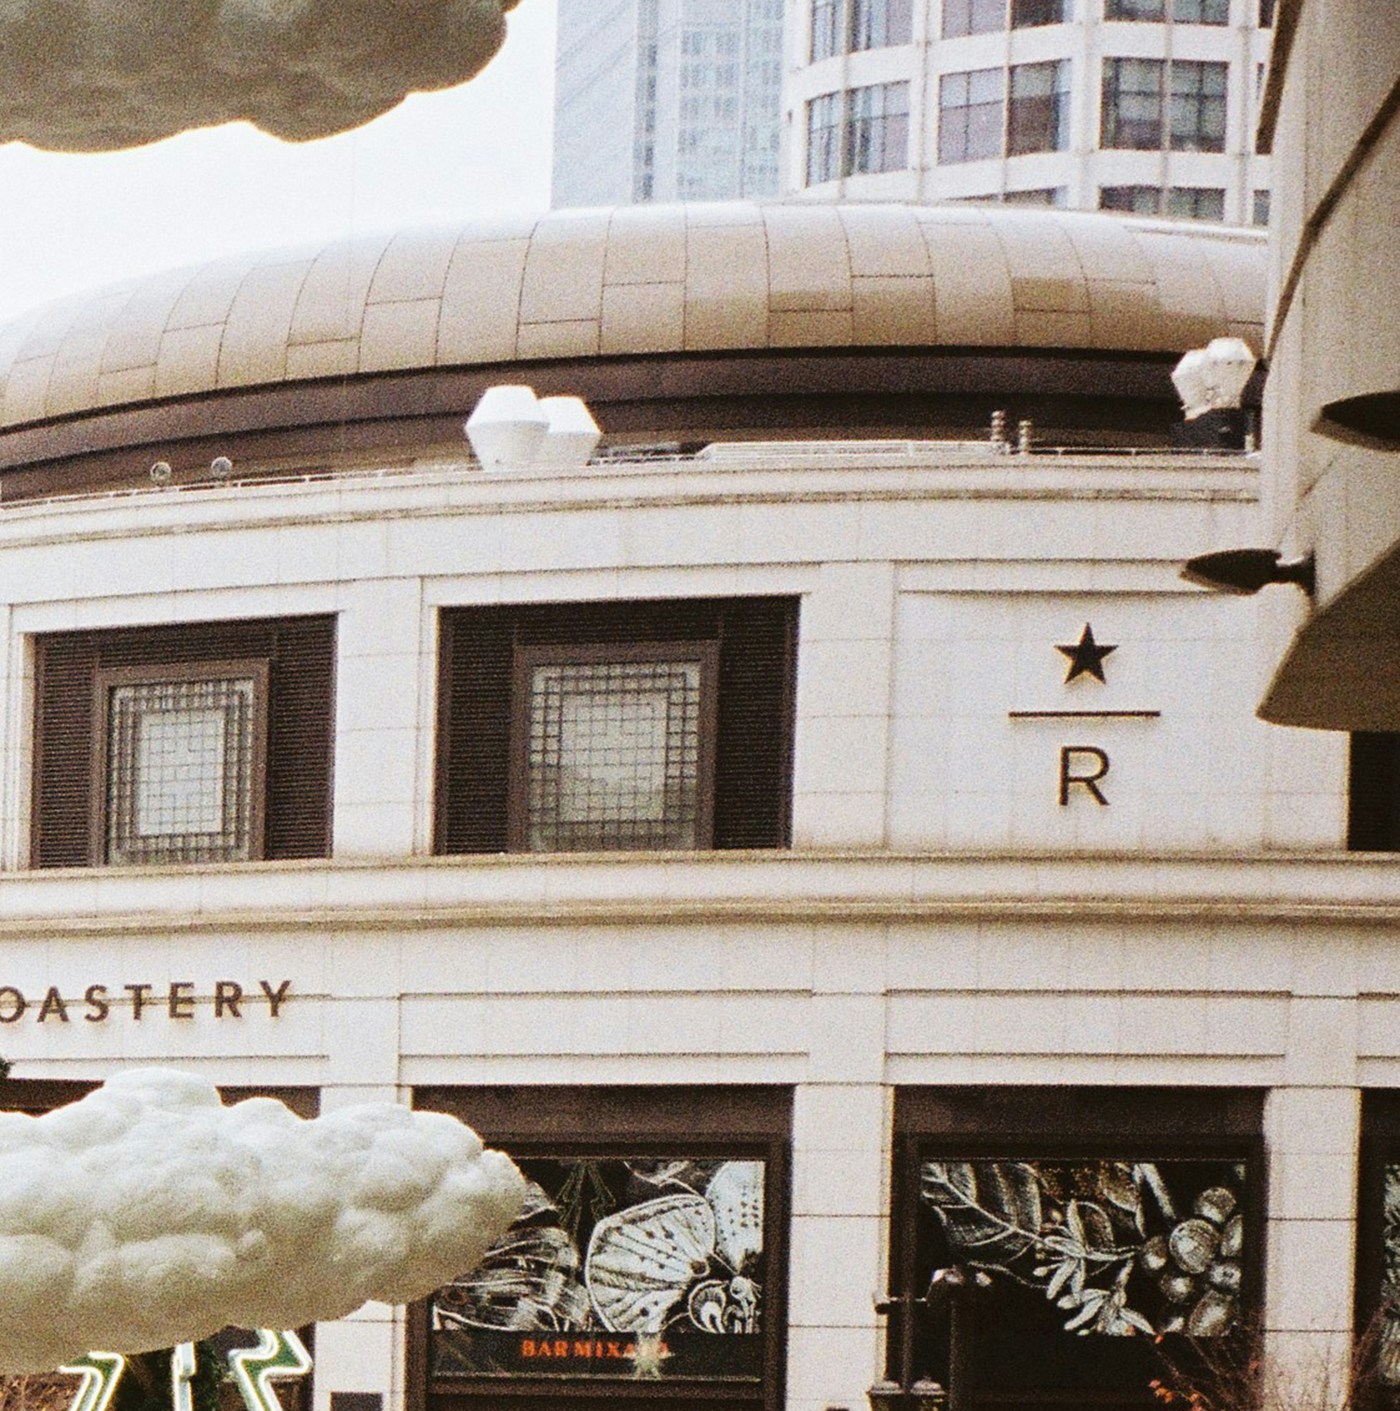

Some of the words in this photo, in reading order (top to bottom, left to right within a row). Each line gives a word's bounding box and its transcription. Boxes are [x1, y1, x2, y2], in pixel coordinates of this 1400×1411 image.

[1060, 746, 1109, 806] R
[522, 1339, 568, 1358] BAR
[574, 1340, 669, 1359] MIXA
